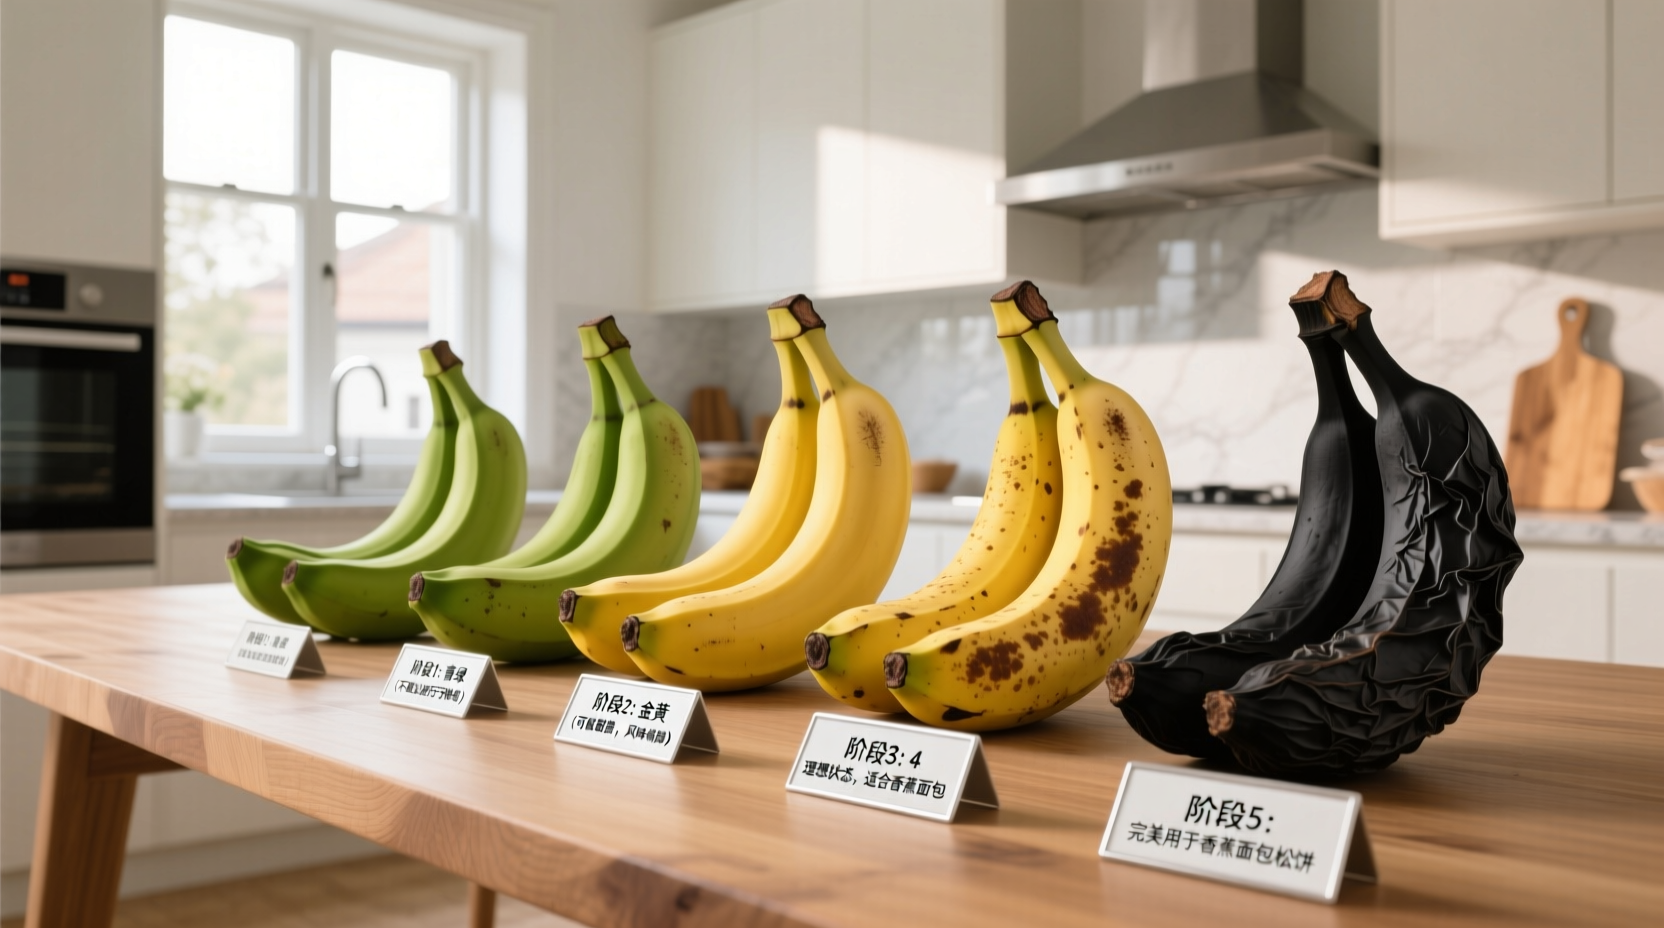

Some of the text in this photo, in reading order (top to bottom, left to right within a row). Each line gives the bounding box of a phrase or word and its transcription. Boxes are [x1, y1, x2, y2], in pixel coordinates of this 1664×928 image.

[592, 691, 671, 723] 阶段2: 金黄
[844, 736, 923, 769] 阶段3: 4
[1184, 794, 1275, 834] 阶段5:
